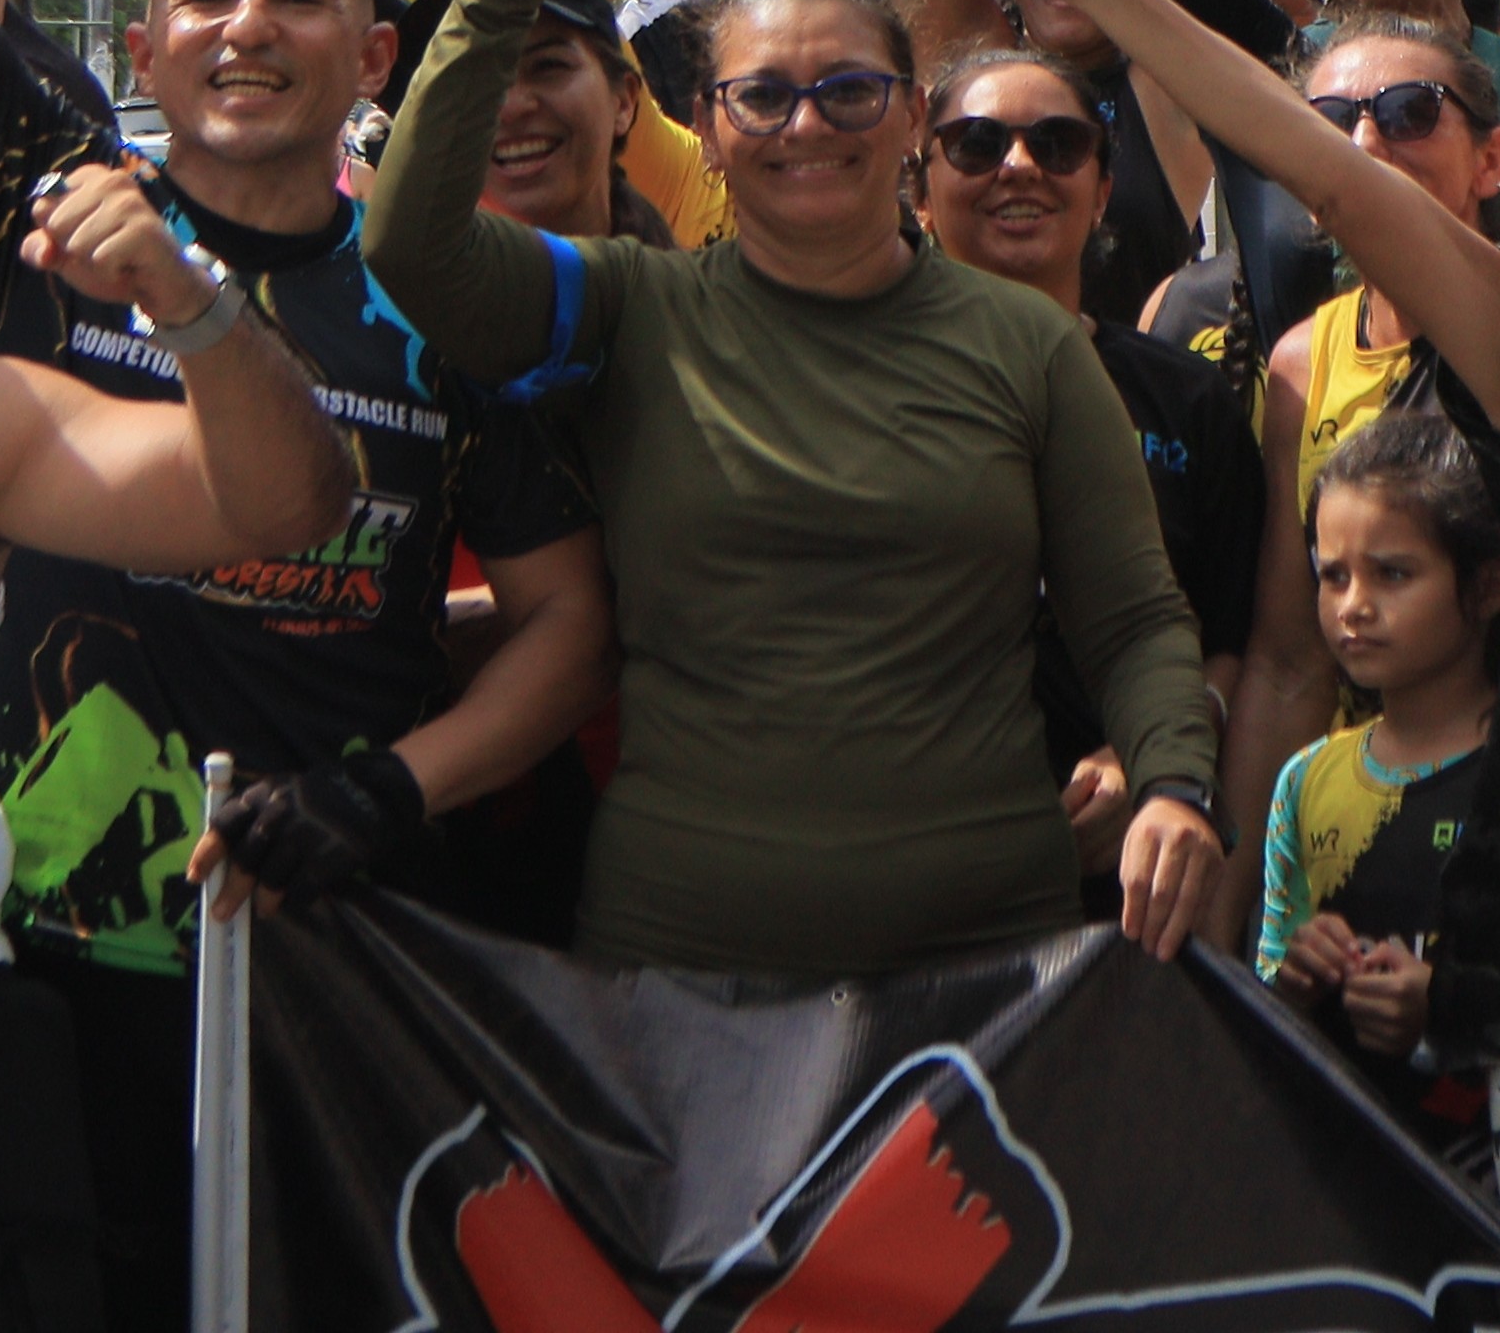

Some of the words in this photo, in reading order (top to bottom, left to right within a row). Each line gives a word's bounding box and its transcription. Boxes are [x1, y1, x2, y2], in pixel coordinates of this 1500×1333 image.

[71, 320, 185, 382] COMPETID
[310, 383, 408, 432] BSTACLE
[411, 406, 449, 441] RUN
